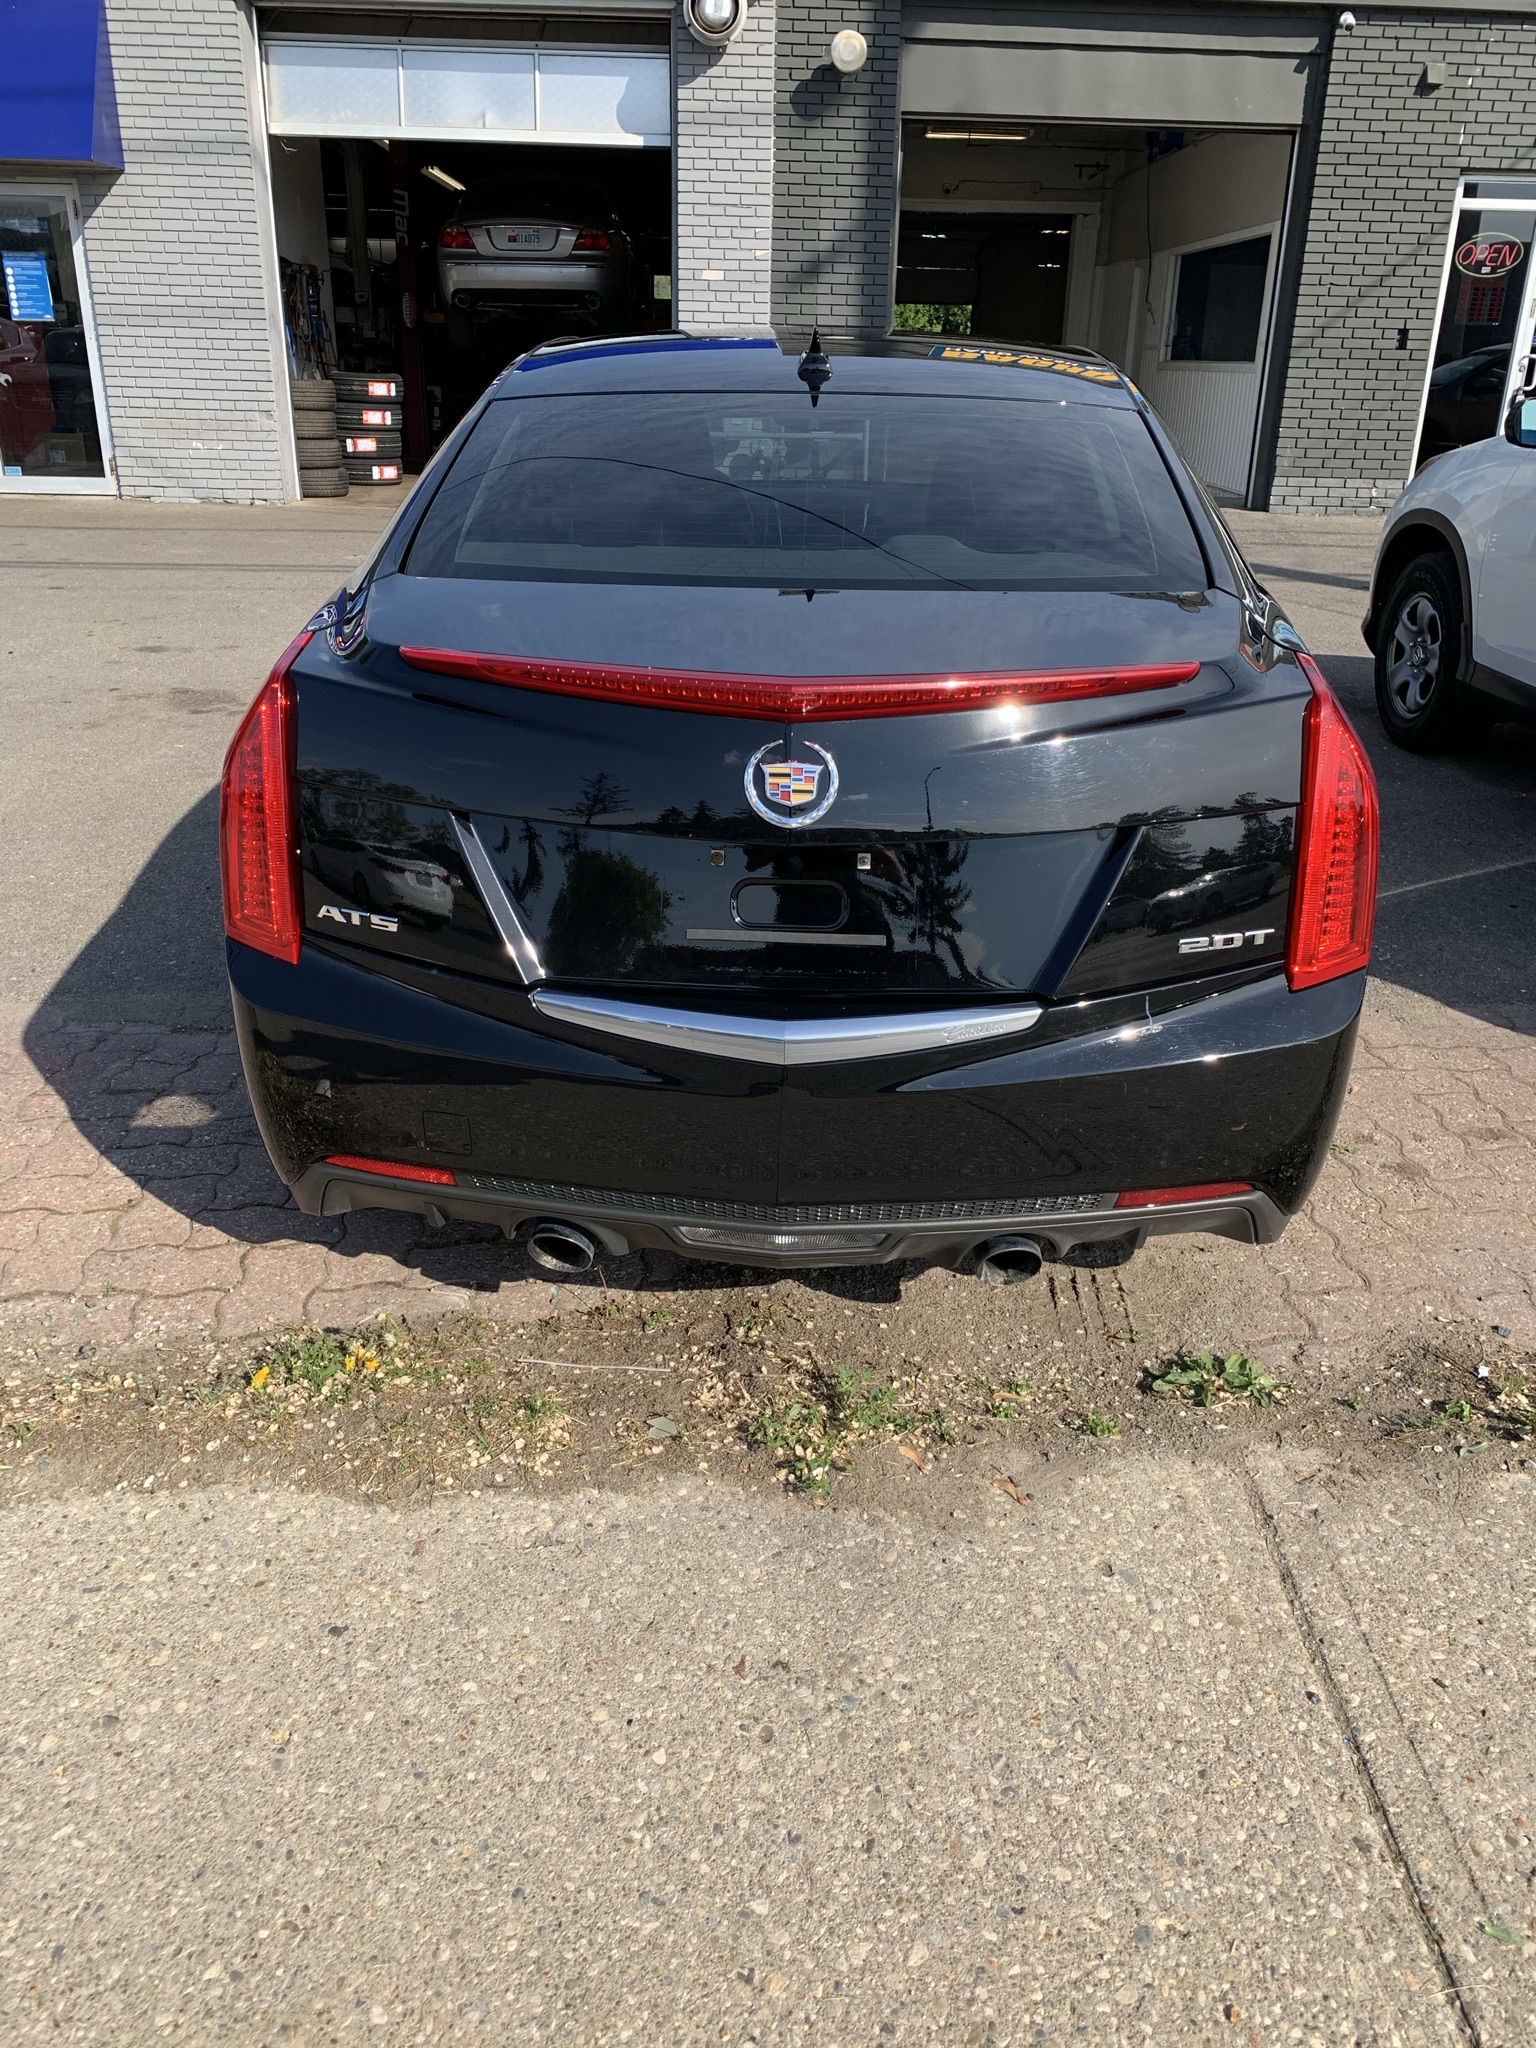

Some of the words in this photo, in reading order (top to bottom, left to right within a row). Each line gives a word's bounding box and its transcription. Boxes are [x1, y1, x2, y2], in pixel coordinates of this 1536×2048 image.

[1459, 244, 1519, 266] OPEN
[317, 905, 399, 933] ATS
[943, 1023, 1008, 1043] Cadillac
